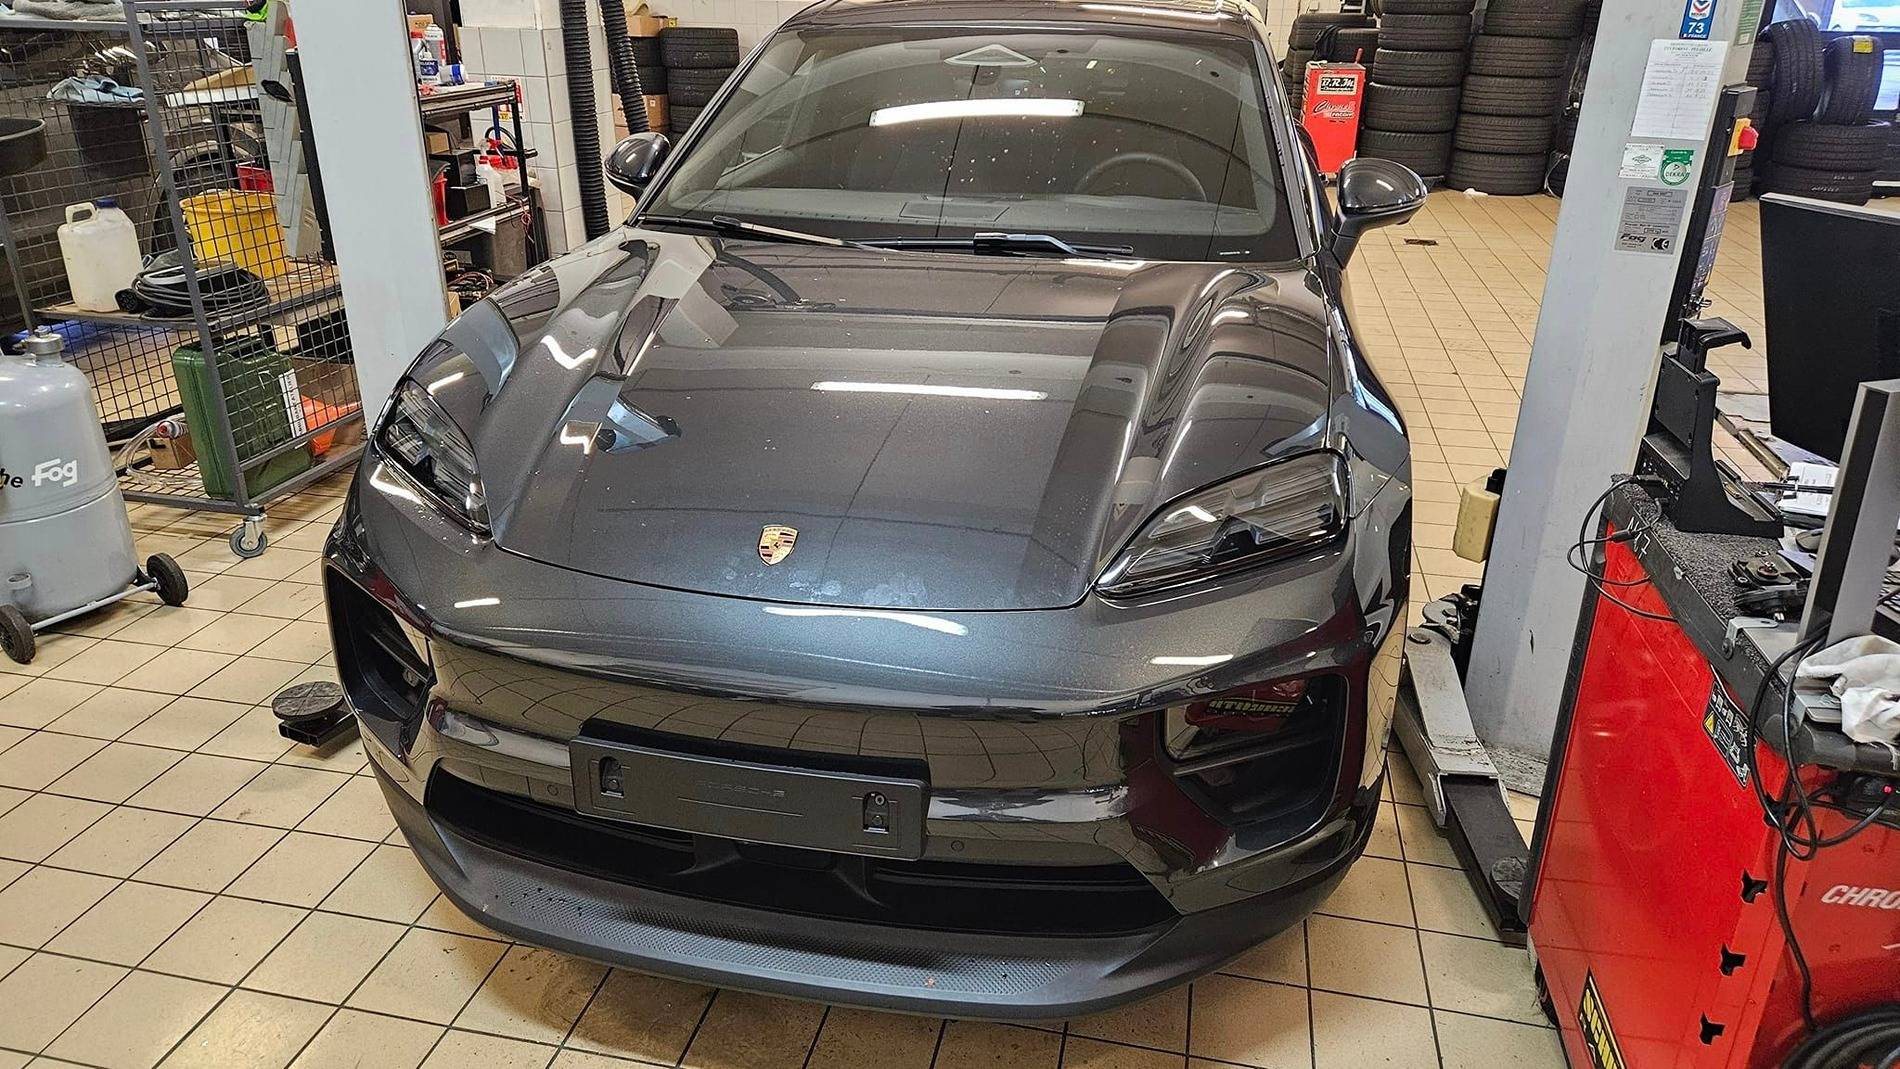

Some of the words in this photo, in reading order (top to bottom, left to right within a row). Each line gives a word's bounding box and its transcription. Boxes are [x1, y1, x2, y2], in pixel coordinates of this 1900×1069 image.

[1688, 22, 1705, 34] 73
[31, 458, 78, 488] Fog
[1821, 885, 1900, 910] CHRO
